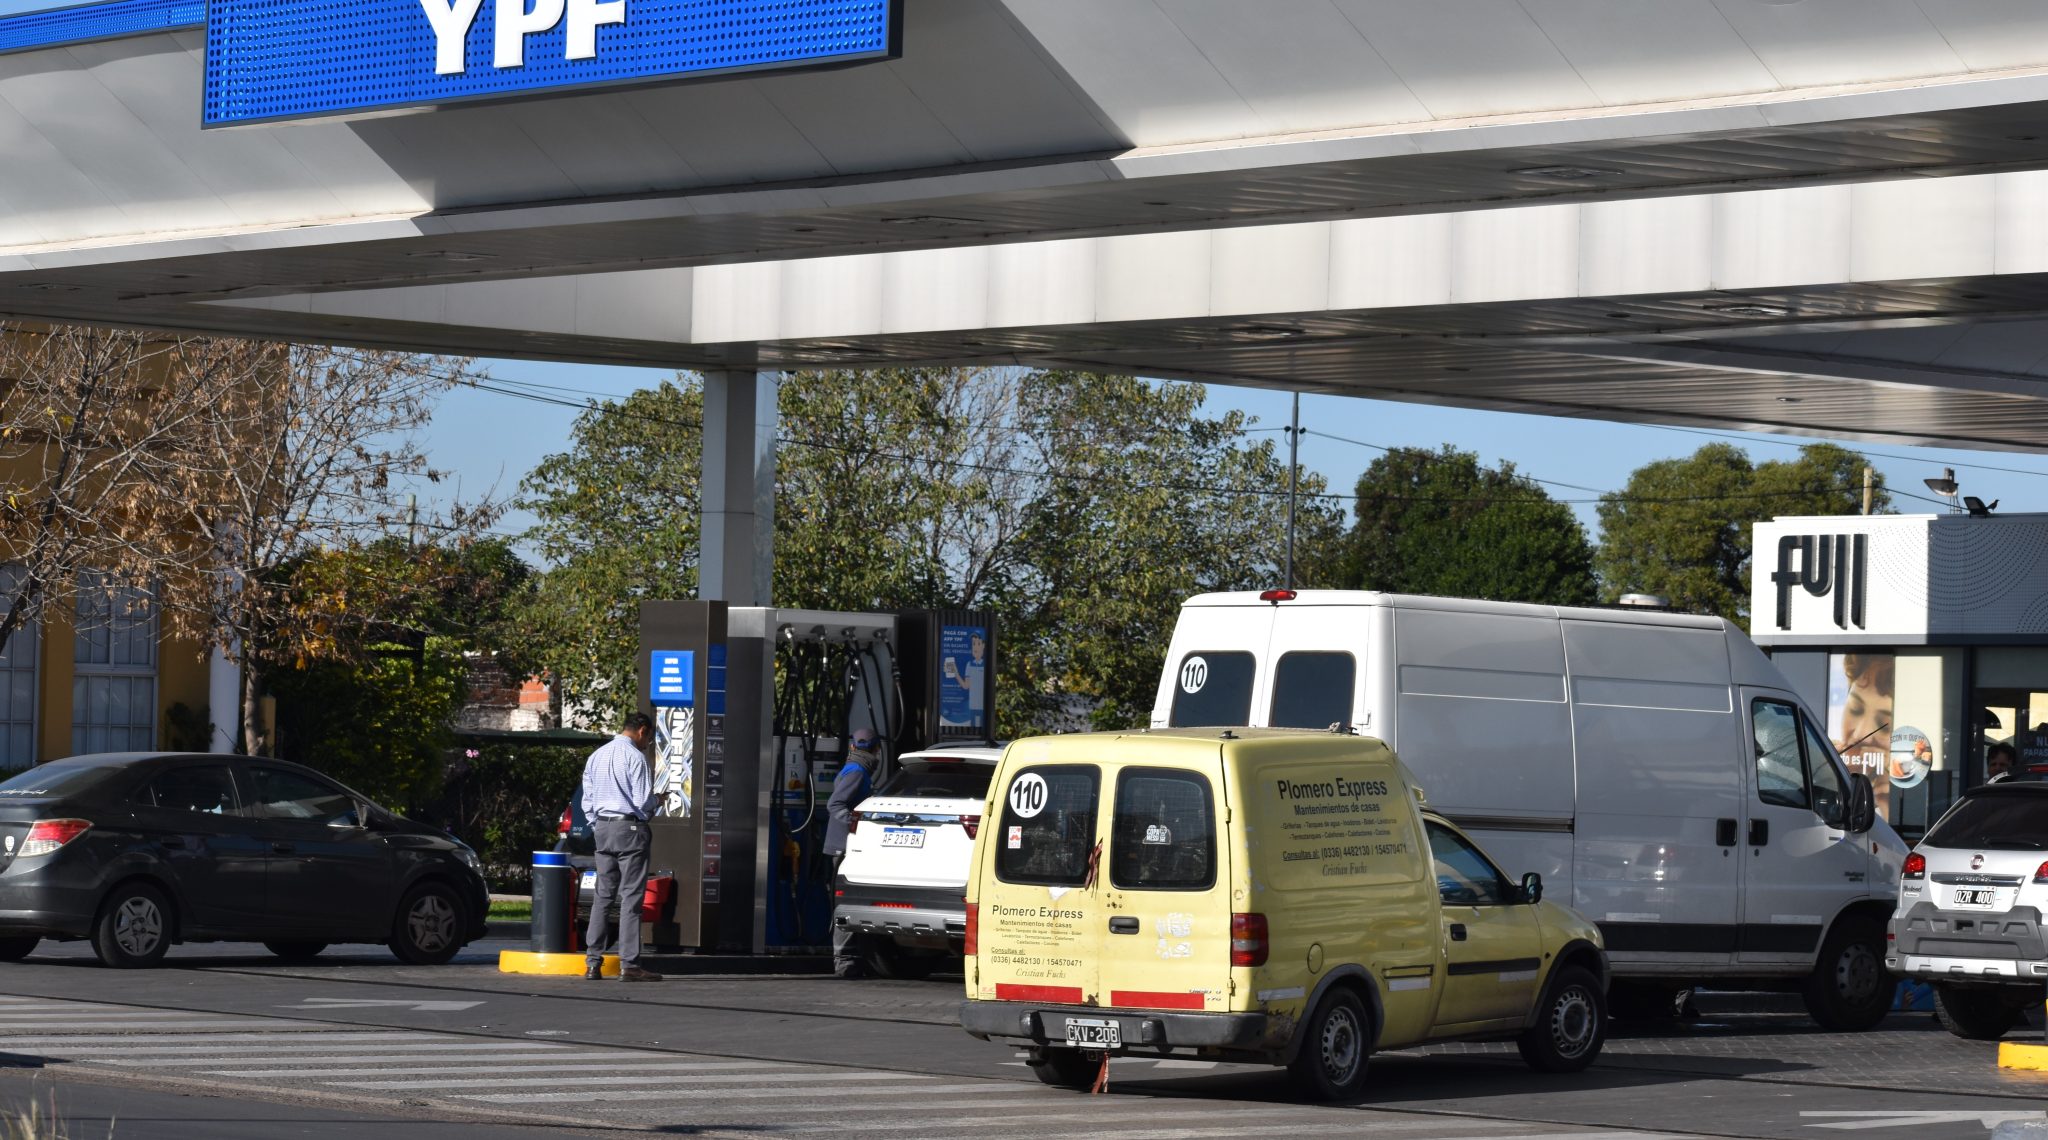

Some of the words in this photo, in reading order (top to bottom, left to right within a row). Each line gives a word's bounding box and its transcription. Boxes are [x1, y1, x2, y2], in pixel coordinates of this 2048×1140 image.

[420, 0, 626, 75] YPF
[1185, 663, 1205, 688] 110
[669, 711, 686, 812] INFINIA
[1852, 756, 1860, 765] es
[1014, 780, 1043, 809] 110
[1277, 779, 1334, 799] Plomero
[1336, 777, 1388, 800] Express
[1294, 803, 1349, 815] Mantenimientos
[1352, 802, 1359, 812] de
[1360, 802, 1381, 812] casas
[882, 833, 893, 844] AF
[894, 834, 909, 845] 219
[910, 834, 921, 845] BK
[1282, 849, 1311, 860] Consultas
[1321, 847, 1342, 860] (0336)
[1343, 845, 1370, 857] 4482130
[1375, 843, 1407, 855] 154570471
[1955, 890, 1973, 903] OZR
[1976, 891, 1993, 904] 400
[992, 904, 1036, 917] Plomero
[1039, 906, 1083, 920] Express
[1000, 919, 1045, 927] Mantenimientos
[990, 946, 1017, 954] Consultas
[991, 955, 1010, 965] (0336)
[1012, 956, 1040, 965] 4482130
[1046, 958, 1082, 967] 154570471
[1015, 968, 1044, 977] Cristian
[1067, 1025, 1088, 1042] CKV
